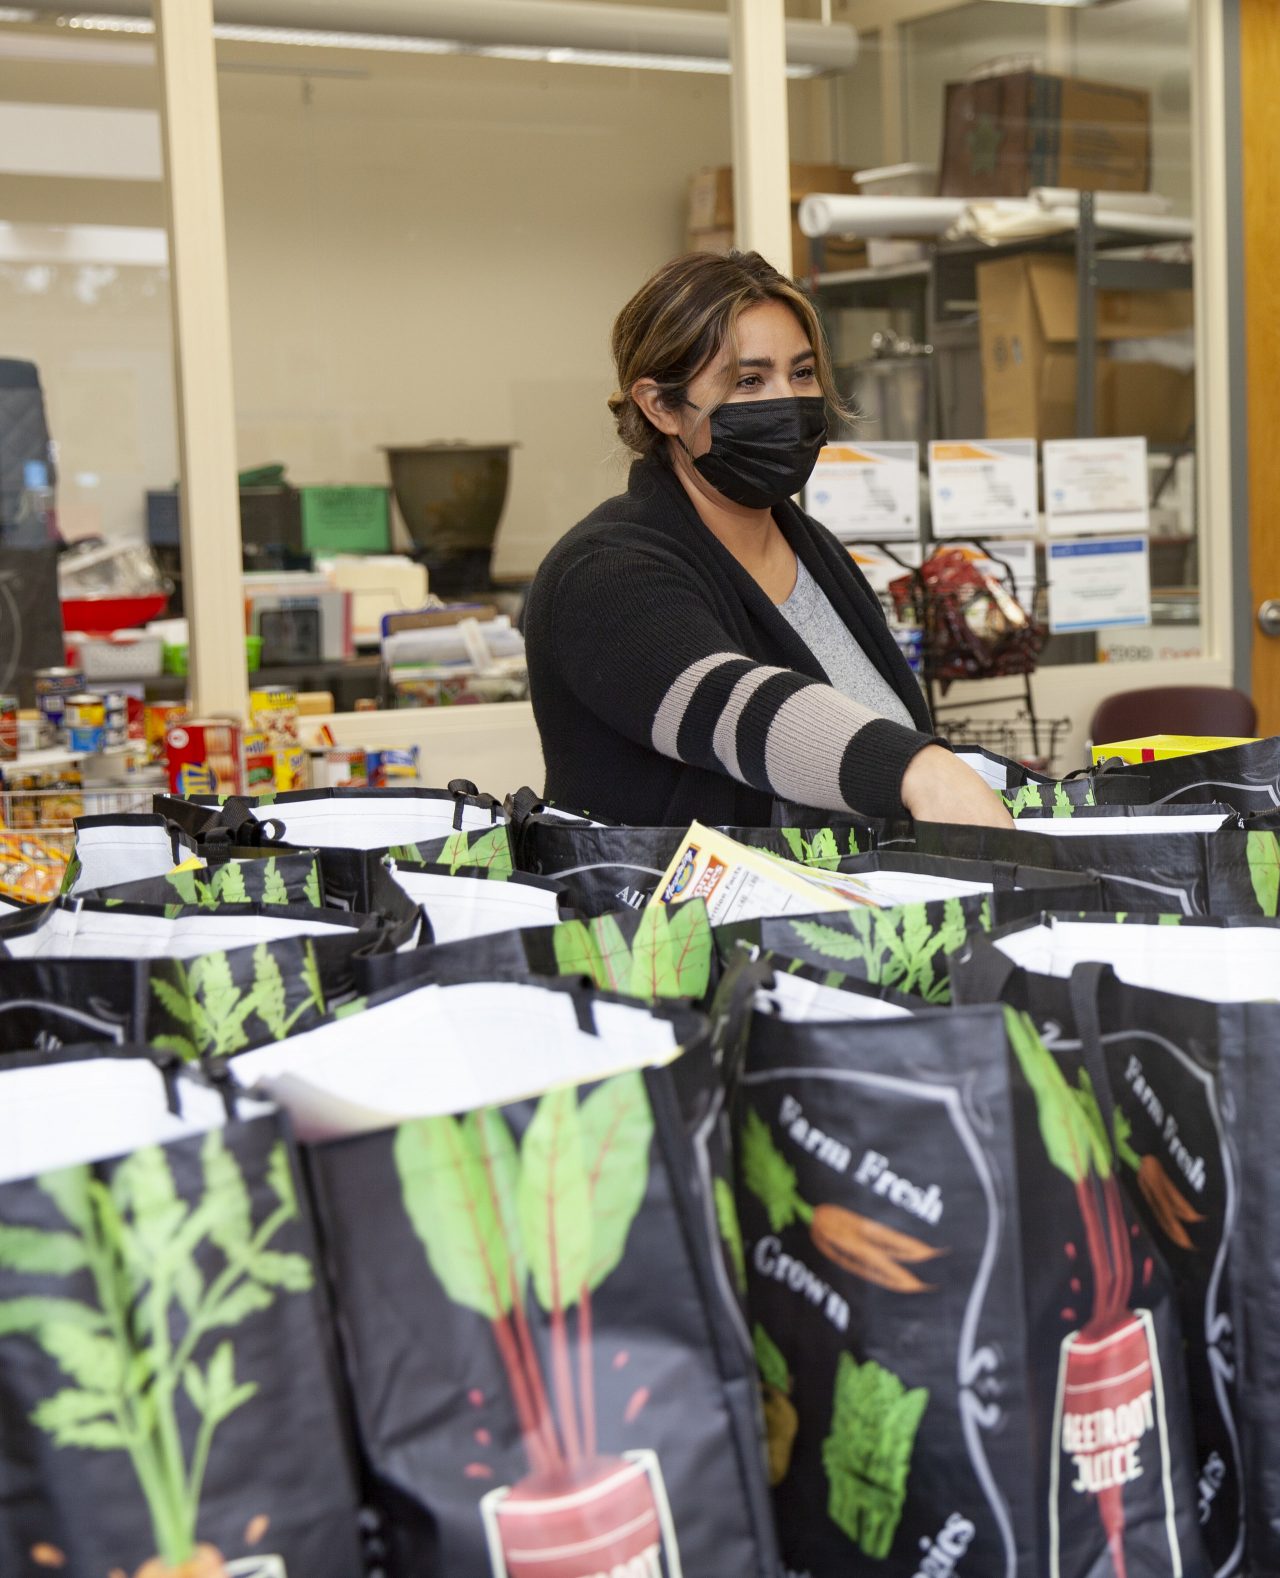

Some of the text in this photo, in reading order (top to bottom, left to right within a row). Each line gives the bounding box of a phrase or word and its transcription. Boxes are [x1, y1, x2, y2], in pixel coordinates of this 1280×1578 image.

[615, 886, 645, 910] All
[1125, 1054, 1206, 1192] Farm Fresh
[779, 1094, 944, 1225] Farm Fresh
[1061, 1390, 1153, 1453] BEETROOT
[1072, 1441, 1144, 1493] JUICE
